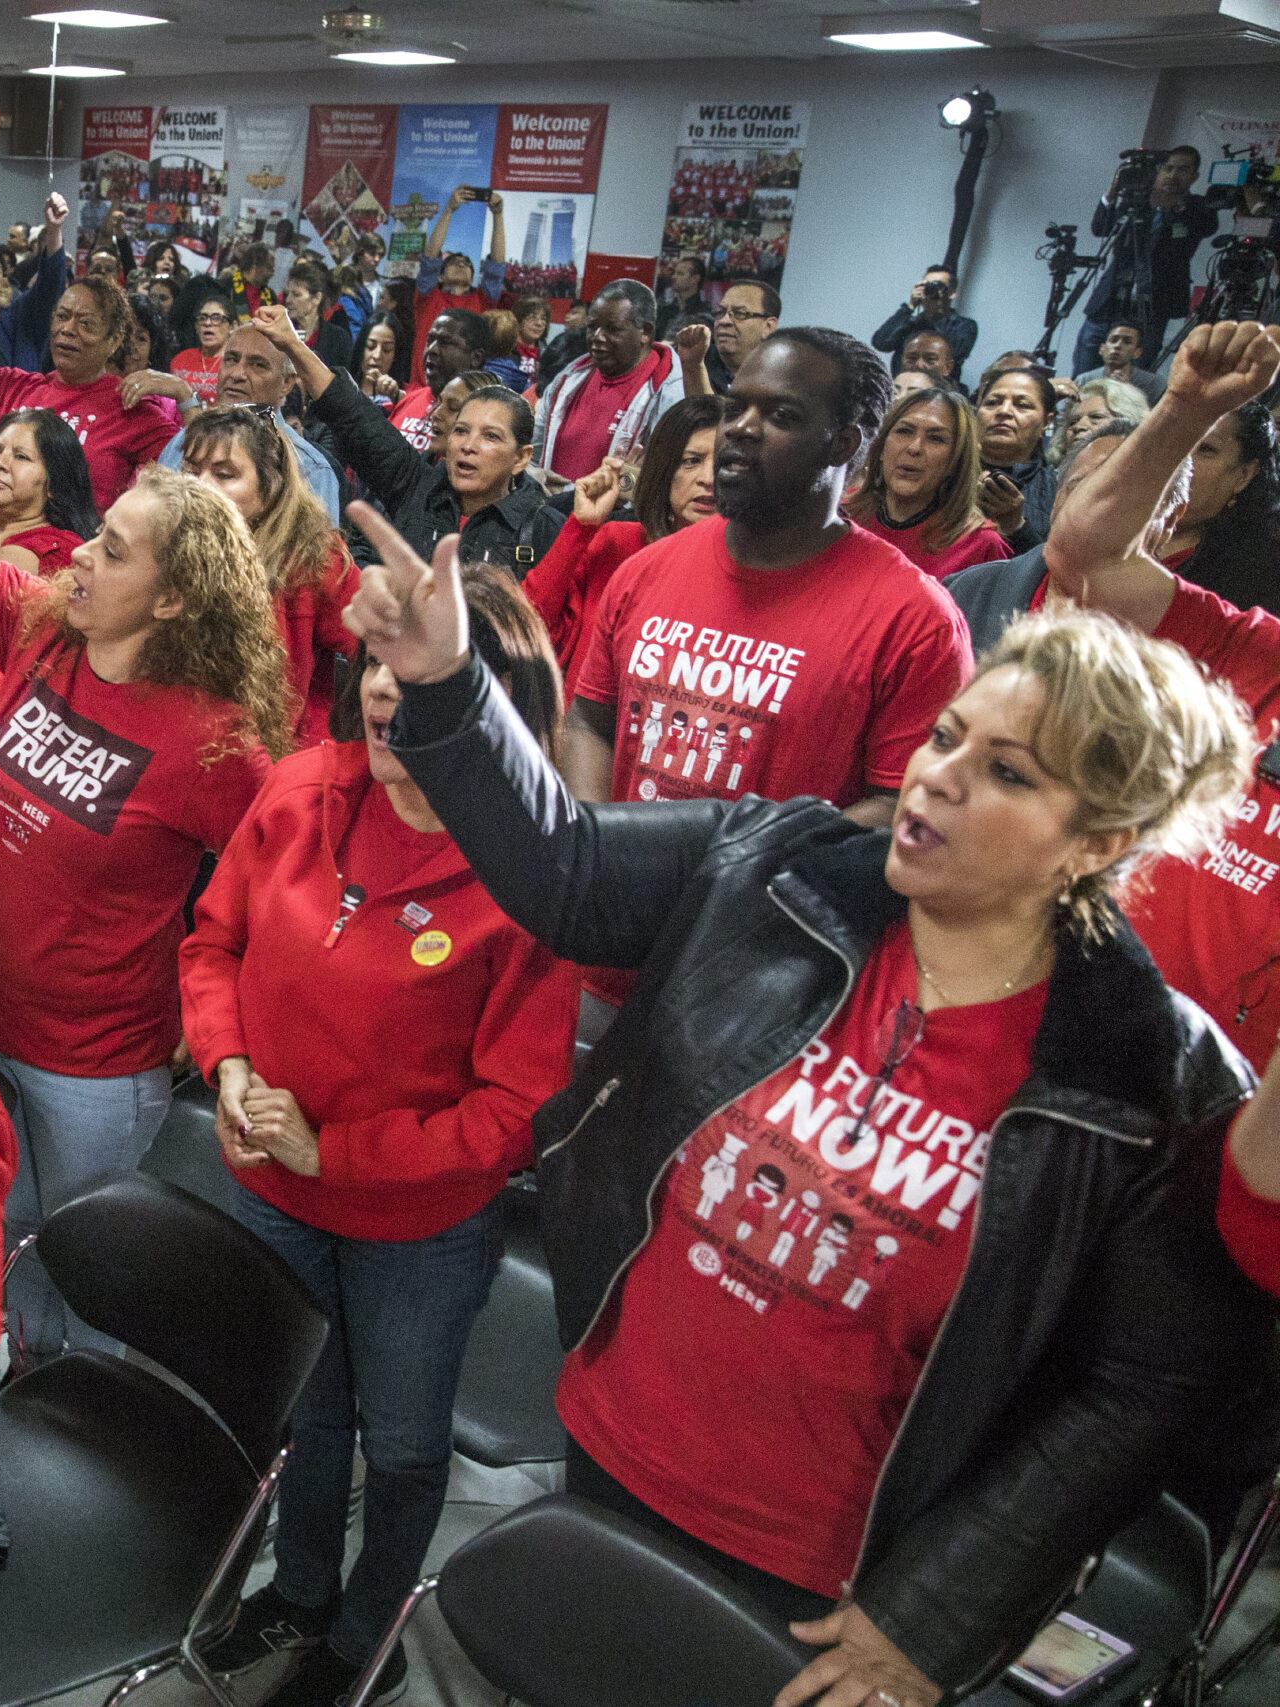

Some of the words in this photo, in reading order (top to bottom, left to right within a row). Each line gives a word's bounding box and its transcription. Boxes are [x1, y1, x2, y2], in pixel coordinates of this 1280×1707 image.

[92, 110, 143, 124] WELCOME
[162, 111, 218, 125] WELCOME
[512, 113, 591, 131] Welcome
[699, 105, 792, 120] WELCOME
[86, 127, 96, 138] to
[99, 126, 113, 138] the
[156, 129, 166, 140] to
[170, 128, 185, 140] the
[189, 128, 223, 141] Union!
[687, 124, 704, 138] to
[710, 123, 737, 138] the
[743, 123, 801, 138] Union!
[1221, 121, 1280, 131] CULINAR
[511, 136, 522, 149] to
[525, 135, 544, 150] the
[547, 136, 587, 151] Union!
[641, 616, 694, 649] OUR
[692, 627, 806, 677] FUTURE
[627, 640, 664, 679] IS
[668, 651, 792, 714] NOW!
[13, 696, 131, 783] DEFEAT
[22, 800, 51, 827] HERE
[1217, 839, 1280, 880] UNITE
[1203, 856, 1267, 895] HERE!
[823, 1055, 993, 1175] FUTURE
[764, 1078, 981, 1231] NOW!
[719, 1274, 768, 1314] HERE
